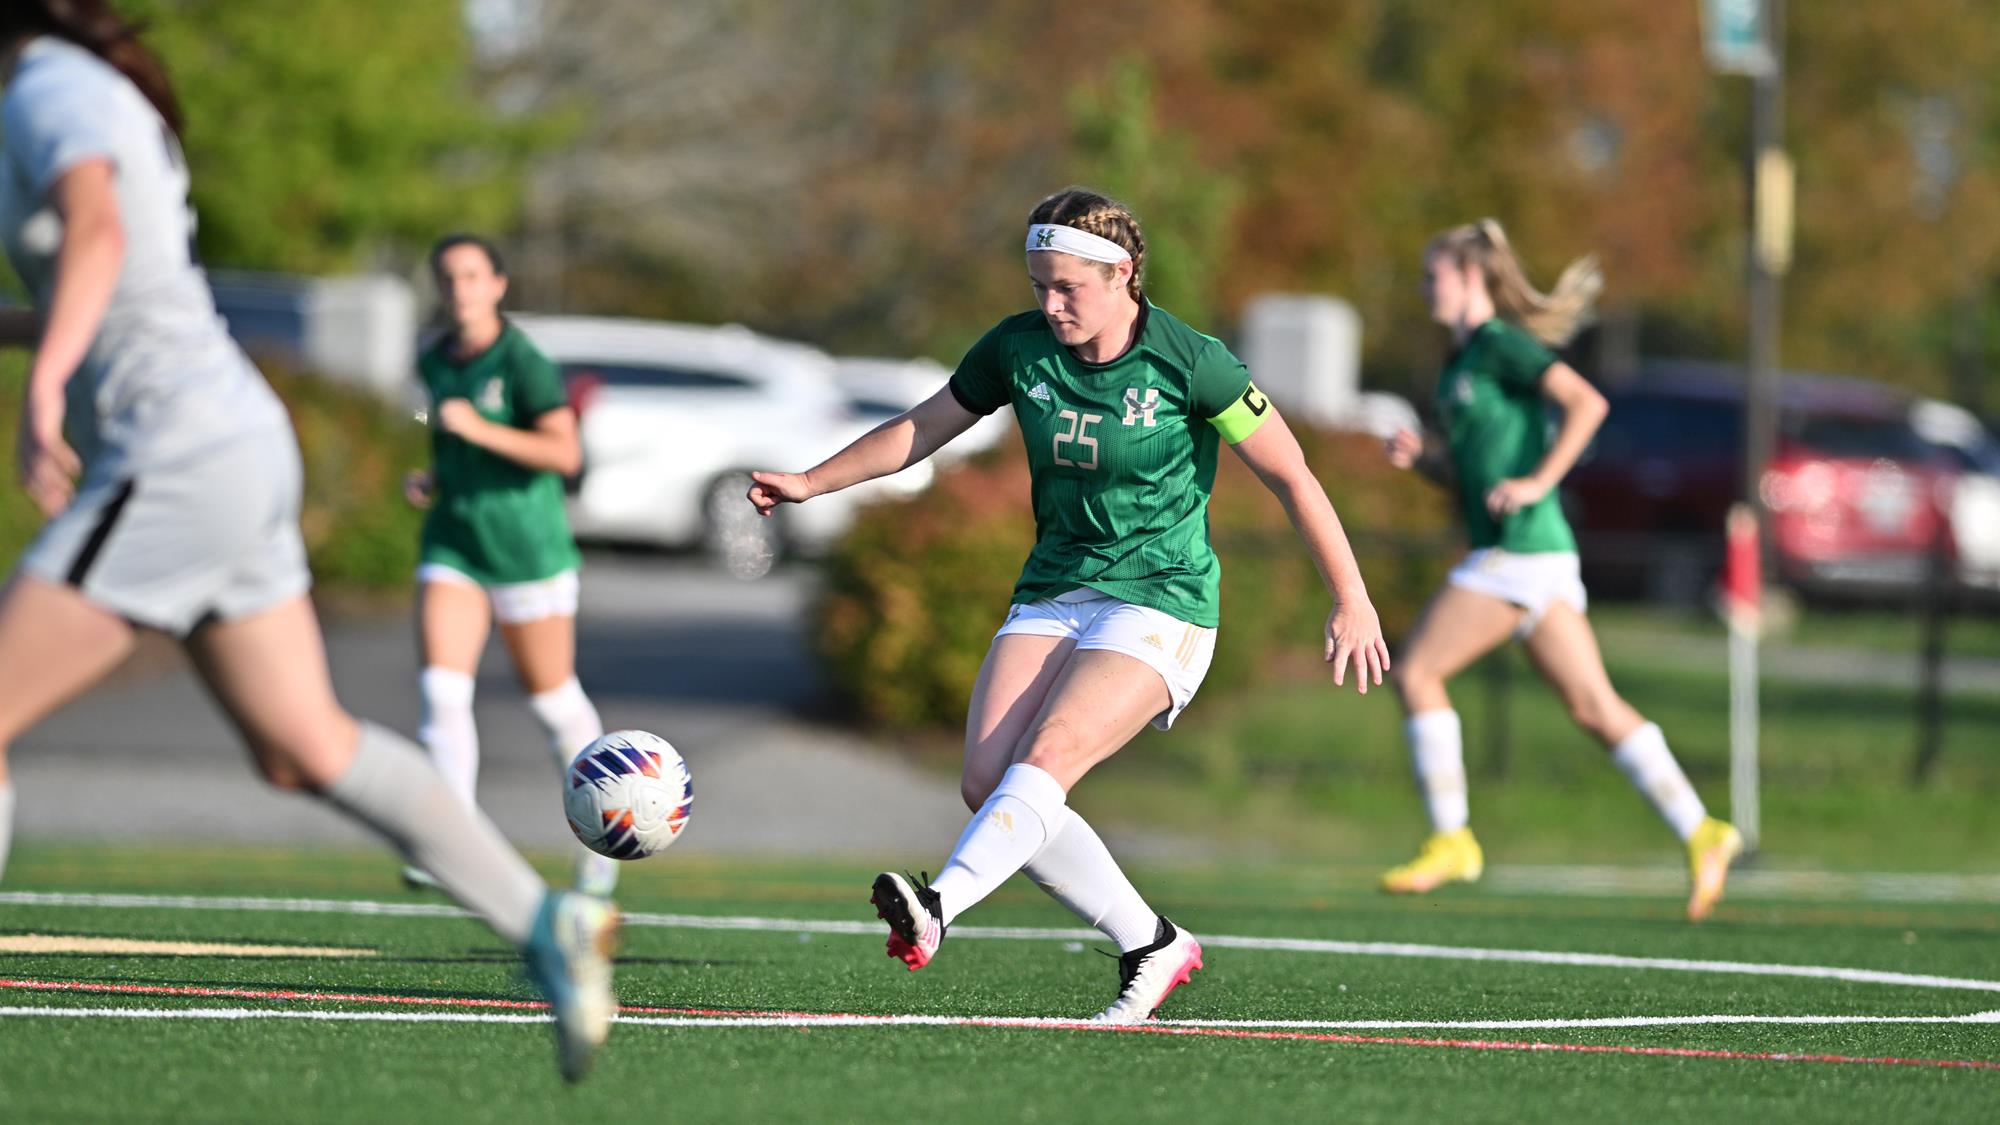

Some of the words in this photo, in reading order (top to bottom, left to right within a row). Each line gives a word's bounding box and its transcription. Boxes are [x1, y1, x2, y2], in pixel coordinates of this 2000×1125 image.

[1028, 390, 1050, 401] adidas
[1122, 388, 1160, 426] H
[1242, 386, 1267, 416] C
[1053, 409, 1103, 470] 25
